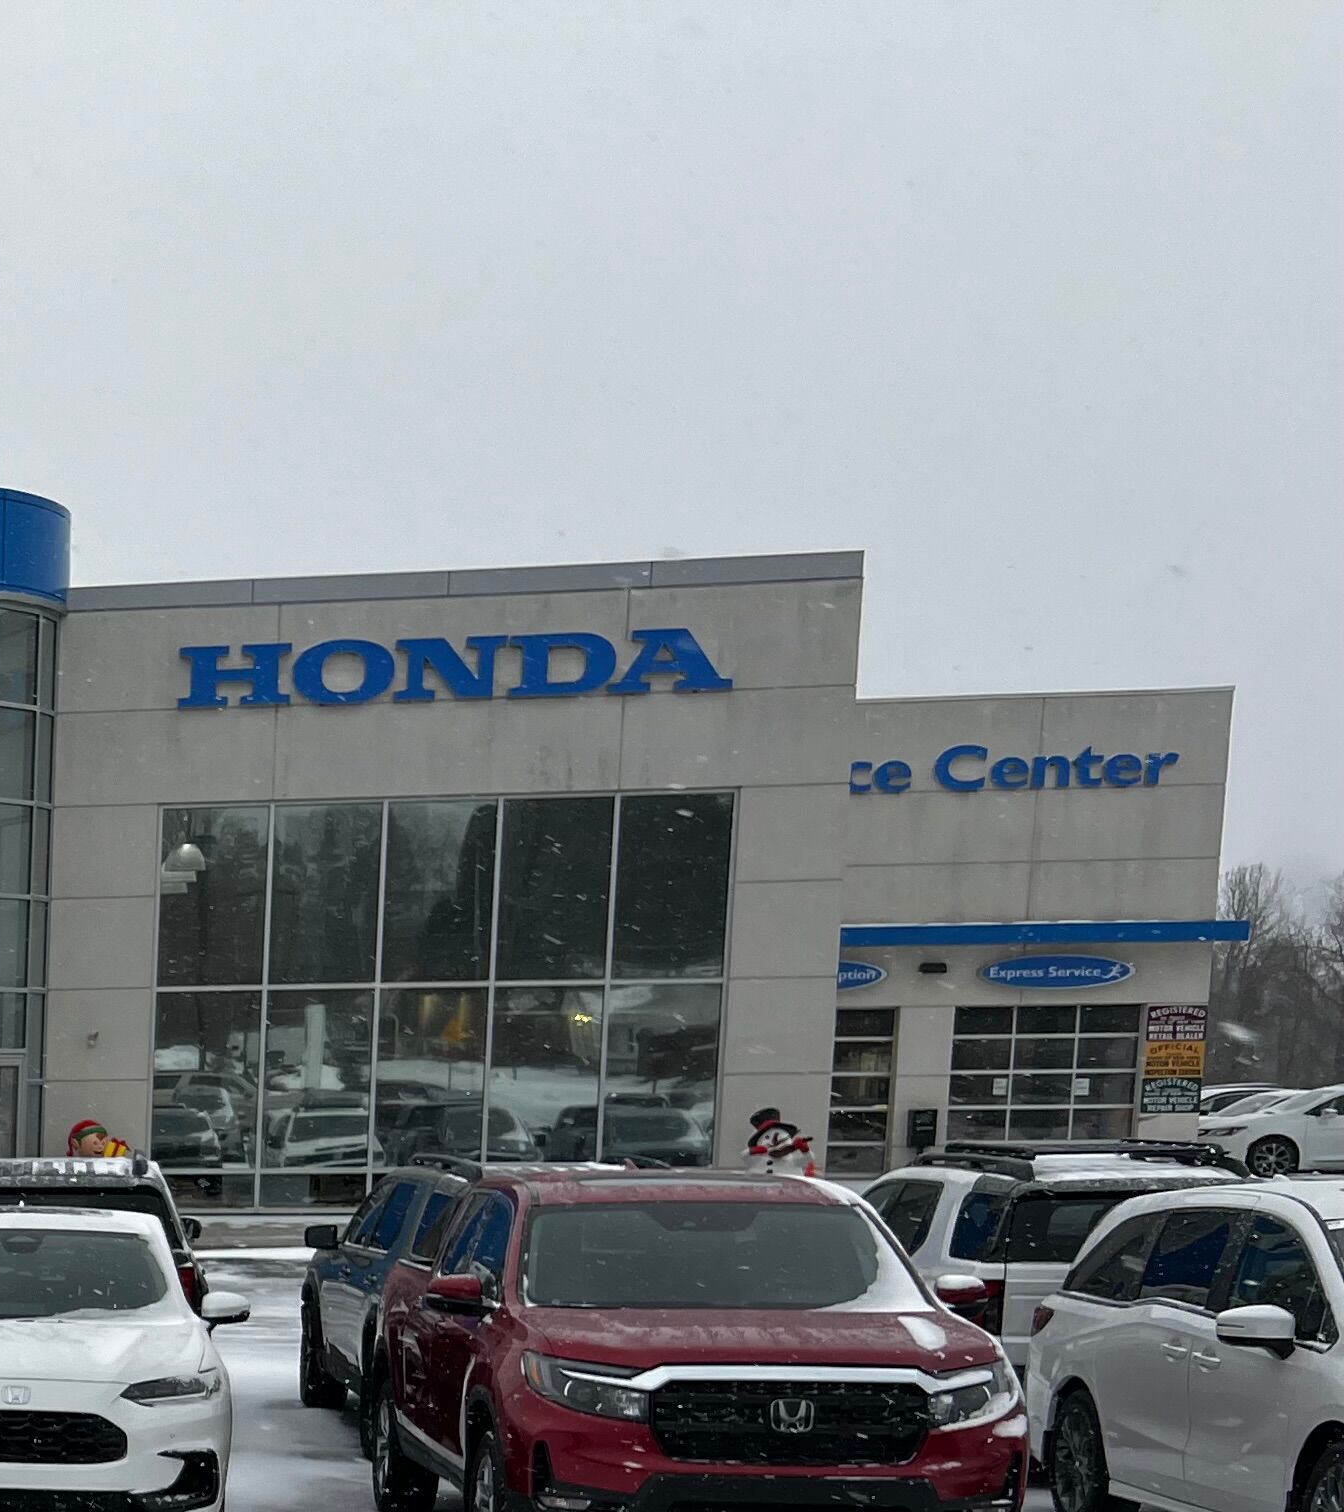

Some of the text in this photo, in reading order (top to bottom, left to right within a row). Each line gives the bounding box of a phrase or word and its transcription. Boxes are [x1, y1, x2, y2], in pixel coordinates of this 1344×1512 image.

[176, 627, 734, 709] HONDA
[934, 743, 1181, 792] Center
[989, 965, 1102, 980] Express Service
[1150, 1006, 1206, 1018] REGISTERED
[1150, 1042, 1200, 1054] OFFICIAL
[1145, 1077, 1199, 1091] REGISTERED
